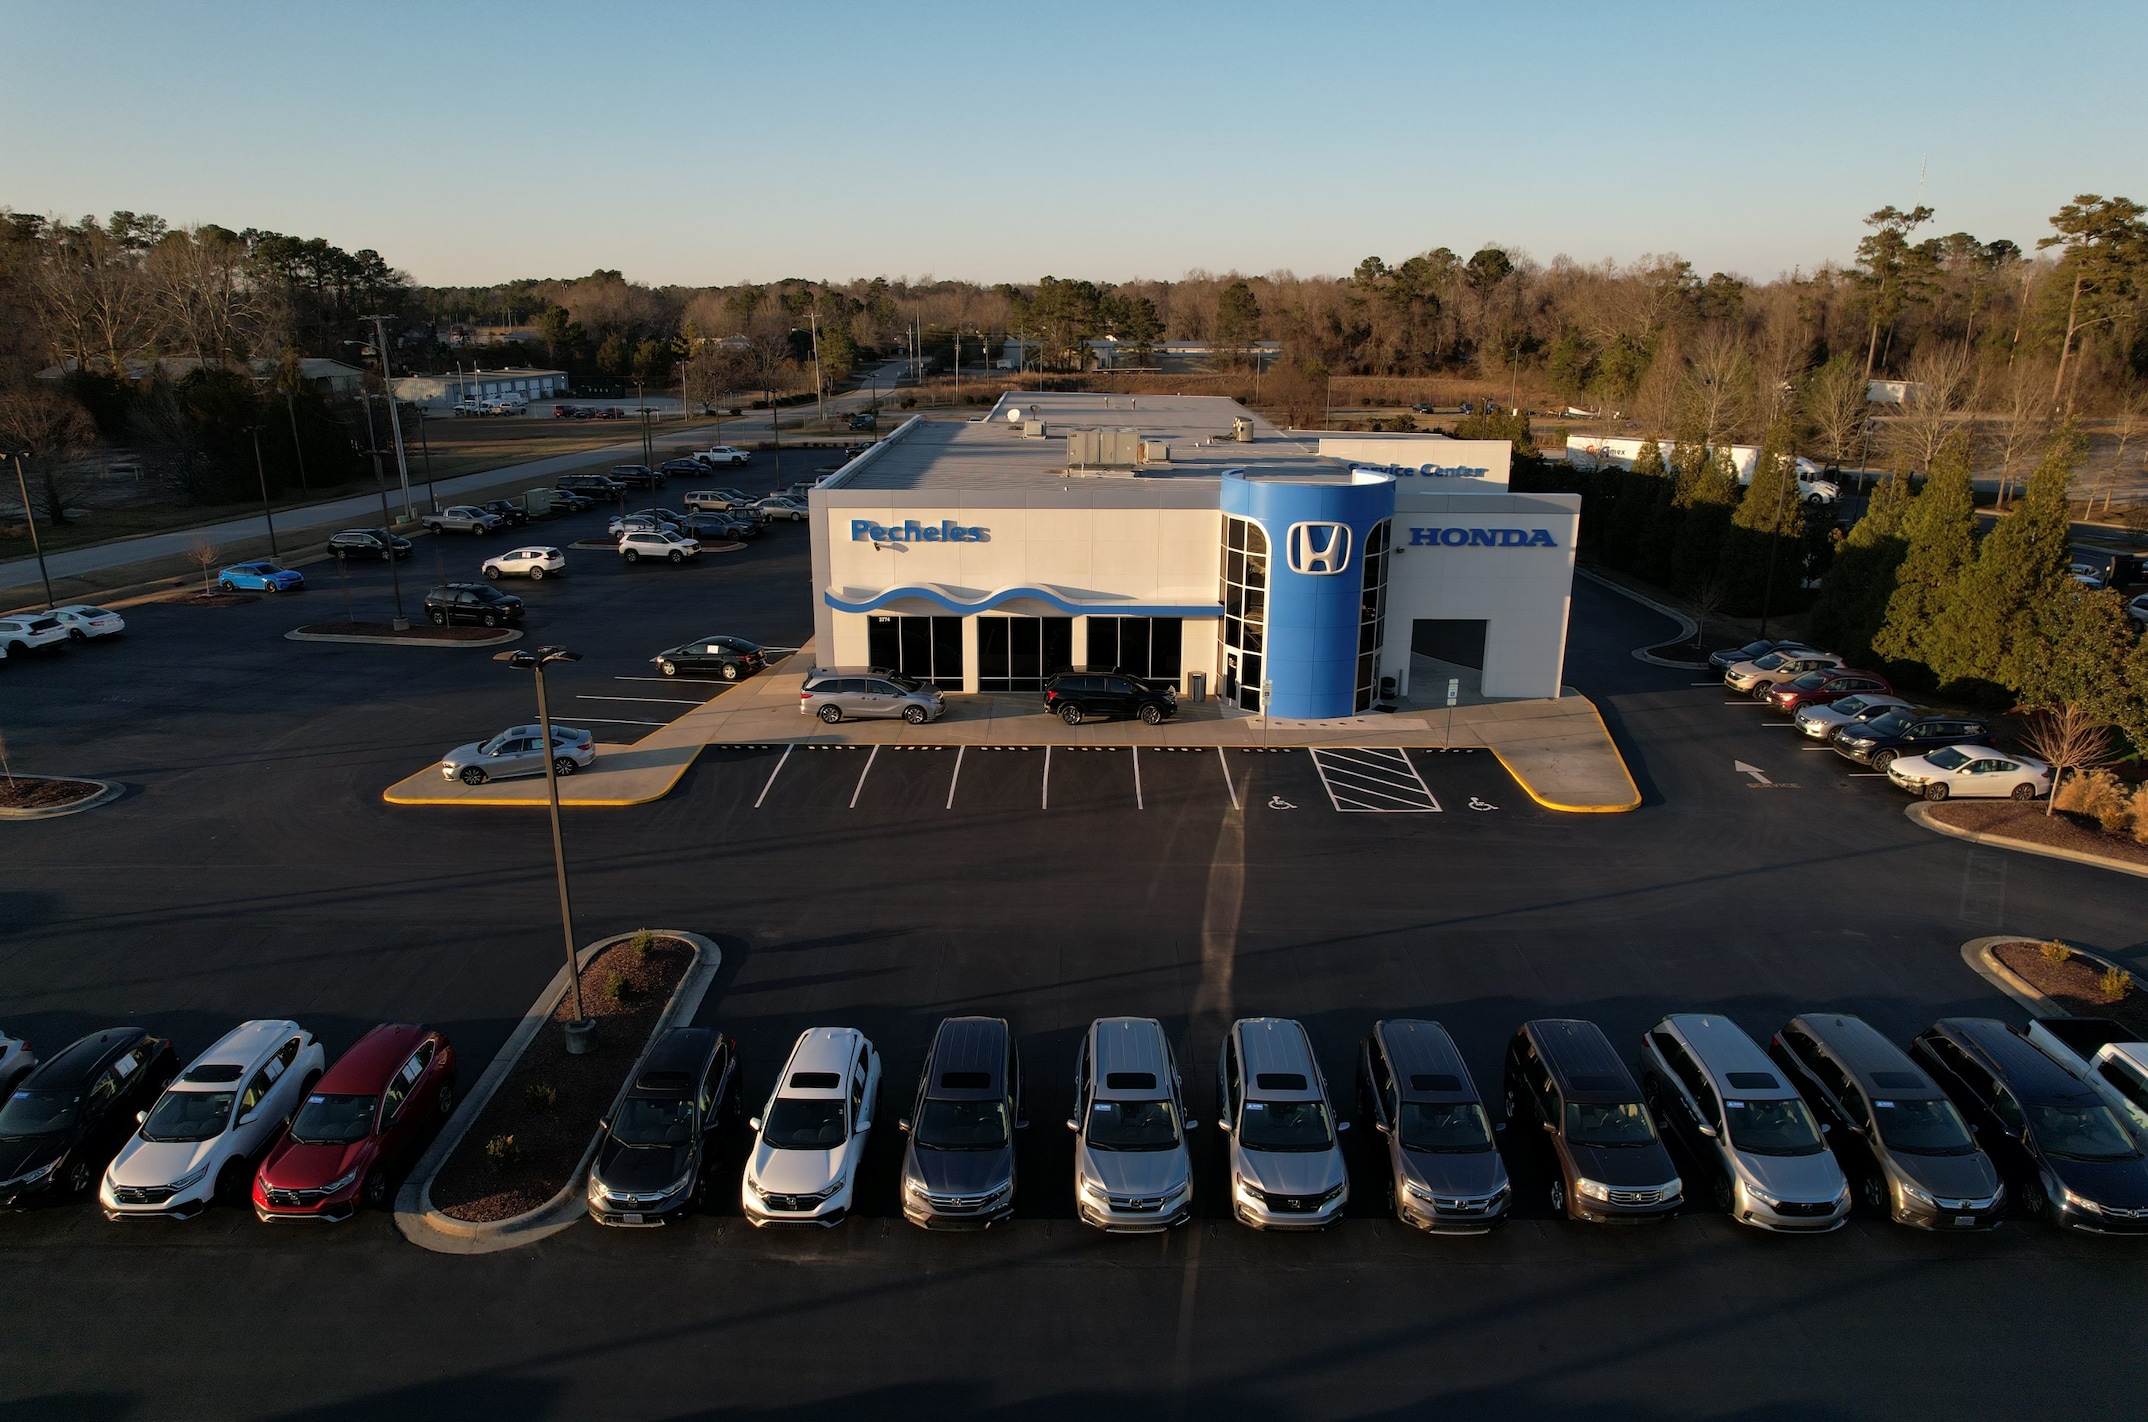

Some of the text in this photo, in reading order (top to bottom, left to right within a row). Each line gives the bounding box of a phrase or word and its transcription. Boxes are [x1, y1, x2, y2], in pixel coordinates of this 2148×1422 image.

[1420, 463, 1487, 477] Center
[851, 519, 983, 542] Pecheles
[1409, 527, 1558, 547] HONDA
